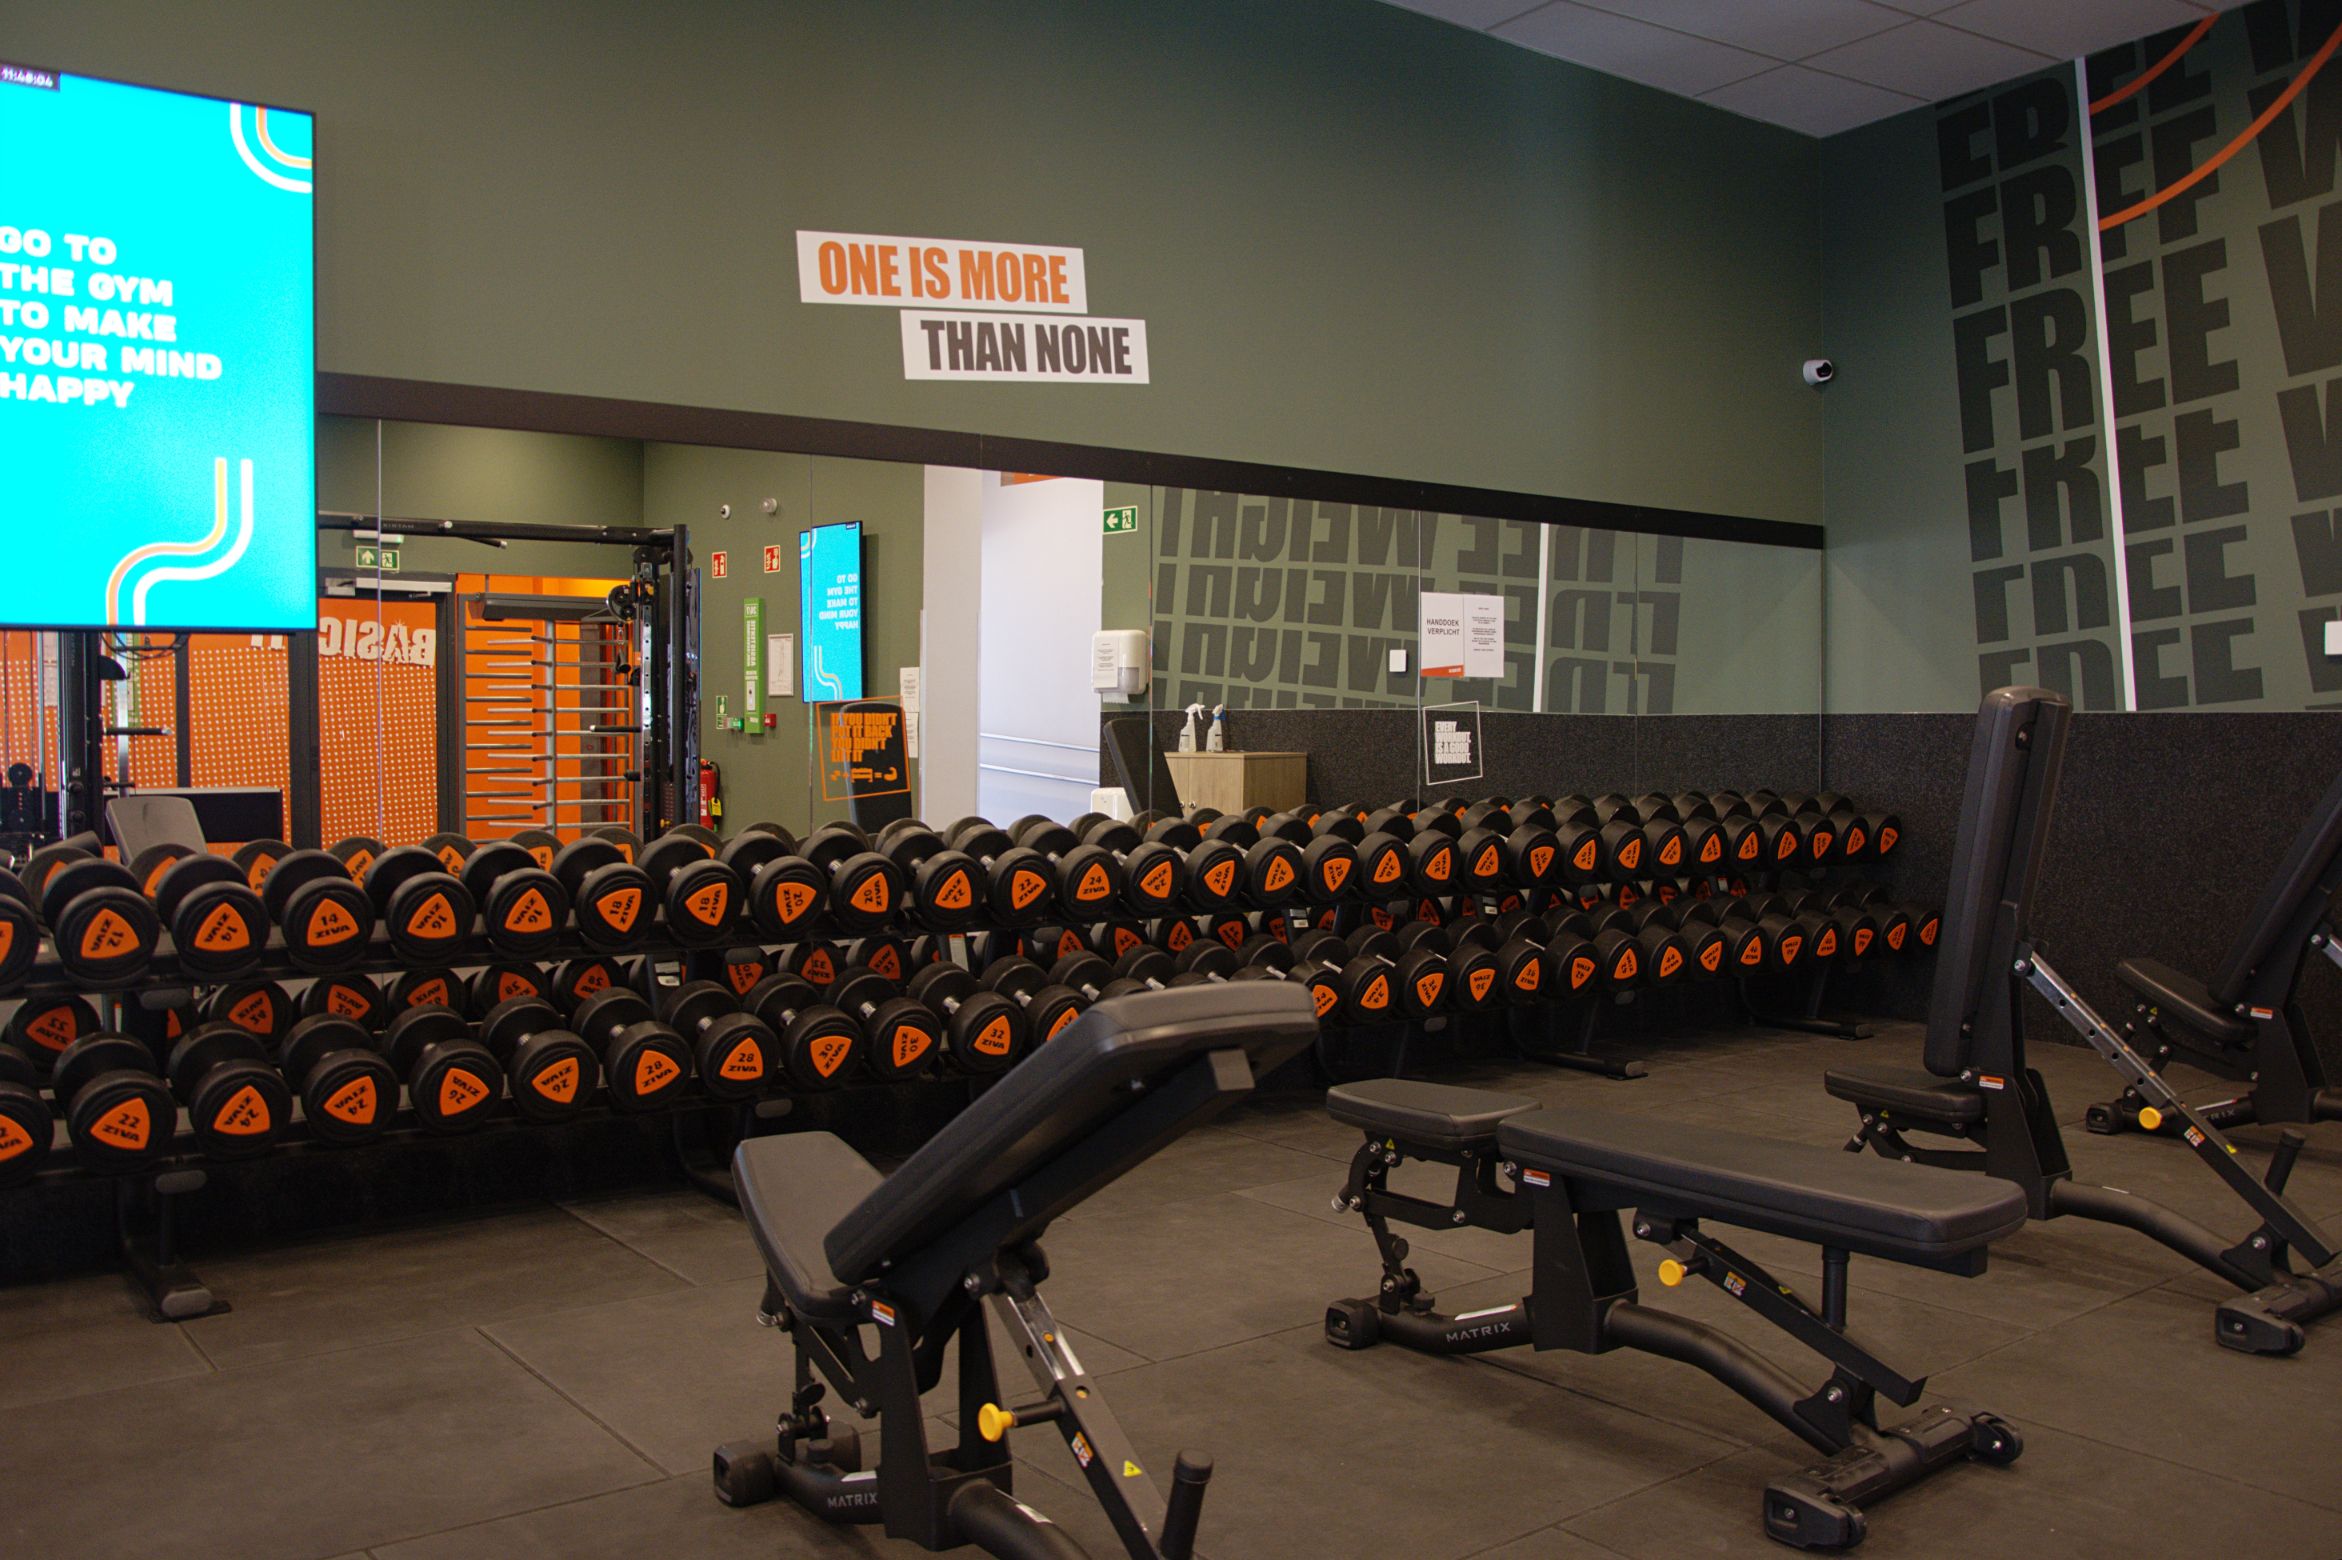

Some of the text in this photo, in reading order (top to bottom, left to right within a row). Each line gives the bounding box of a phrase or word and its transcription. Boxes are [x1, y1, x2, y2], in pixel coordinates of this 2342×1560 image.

[0, 226, 117, 265] GO TO
[818, 240, 1070, 304] ONE IS MORE
[0, 262, 173, 307] THE GYM
[0, 299, 177, 342] TO MAKE
[920, 319, 1133, 375] THAN NONE
[1952, 237, 2240, 453] FREE
[0, 335, 223, 380] YOUR MIND
[0, 372, 135, 408] HAPPY
[1426, 617, 1460, 627] HANDDOEK
[1427, 627, 1460, 636] VERPLICHT
[1434, 720, 1457, 732] EVERY
[1434, 742, 1444, 753] IS
[1450, 742, 1470, 753] GOOD
[1089, 876, 1102, 885] 24
[1147, 869, 1167, 886] ZIVA
[1214, 871, 1222, 884] 26
[1220, 866, 1230, 890] ZIVA
[1270, 862, 1280, 886] ZIVA
[1278, 869, 1286, 882] 26
[942, 878, 960, 902] ZIVA
[1018, 883, 1040, 903] ZIVA
[1019, 878, 1032, 891] 22
[1082, 887, 1105, 895] ZIVA
[1154, 879, 1166, 891] 24
[793, 891, 803, 907] 20
[863, 889, 873, 904] 20
[874, 880, 882, 908] ZIVA
[952, 888, 965, 902] 22
[512, 897, 535, 924] ZIVA
[609, 900, 622, 915] 18
[619, 895, 634, 925] ZIVA
[699, 897, 710, 911] 18
[710, 890, 721, 919] ZIVA
[783, 889, 792, 917] ZIVA
[320, 913, 337, 926] 14
[415, 902, 439, 930] ZIVA
[430, 915, 446, 929] 16
[527, 909, 541, 923] 16
[91, 919, 111, 951] ZIVA
[205, 913, 229, 943] ZIVA
[221, 925, 238, 941] 14
[314, 925, 349, 939] ZIVA
[107, 931, 124, 947] 12
[990, 1029, 1004, 1039] 32
[819, 1044, 833, 1059] 30
[910, 1036, 918, 1053] 30
[982, 1039, 1005, 1049] ZIVA
[738, 1053, 754, 1063] 28
[824, 1043, 844, 1069] ZIVA
[645, 1060, 662, 1074] 28
[541, 1066, 572, 1086] ZIVA
[642, 1068, 673, 1088] ZIVA
[452, 1076, 480, 1096] ZIVA
[552, 1079, 569, 1093] 26
[333, 1086, 367, 1109] ZIVA
[448, 1089, 466, 1104] 26
[222, 1097, 250, 1126] ZIVA
[348, 1099, 367, 1115] 24
[120, 1113, 149, 1128] 22
[238, 1109, 257, 1127] 24
[107, 1123, 150, 1141] ZIVA
[1446, 1321, 1511, 1343] MATRIX
[827, 1492, 878, 1509] MATRIX
